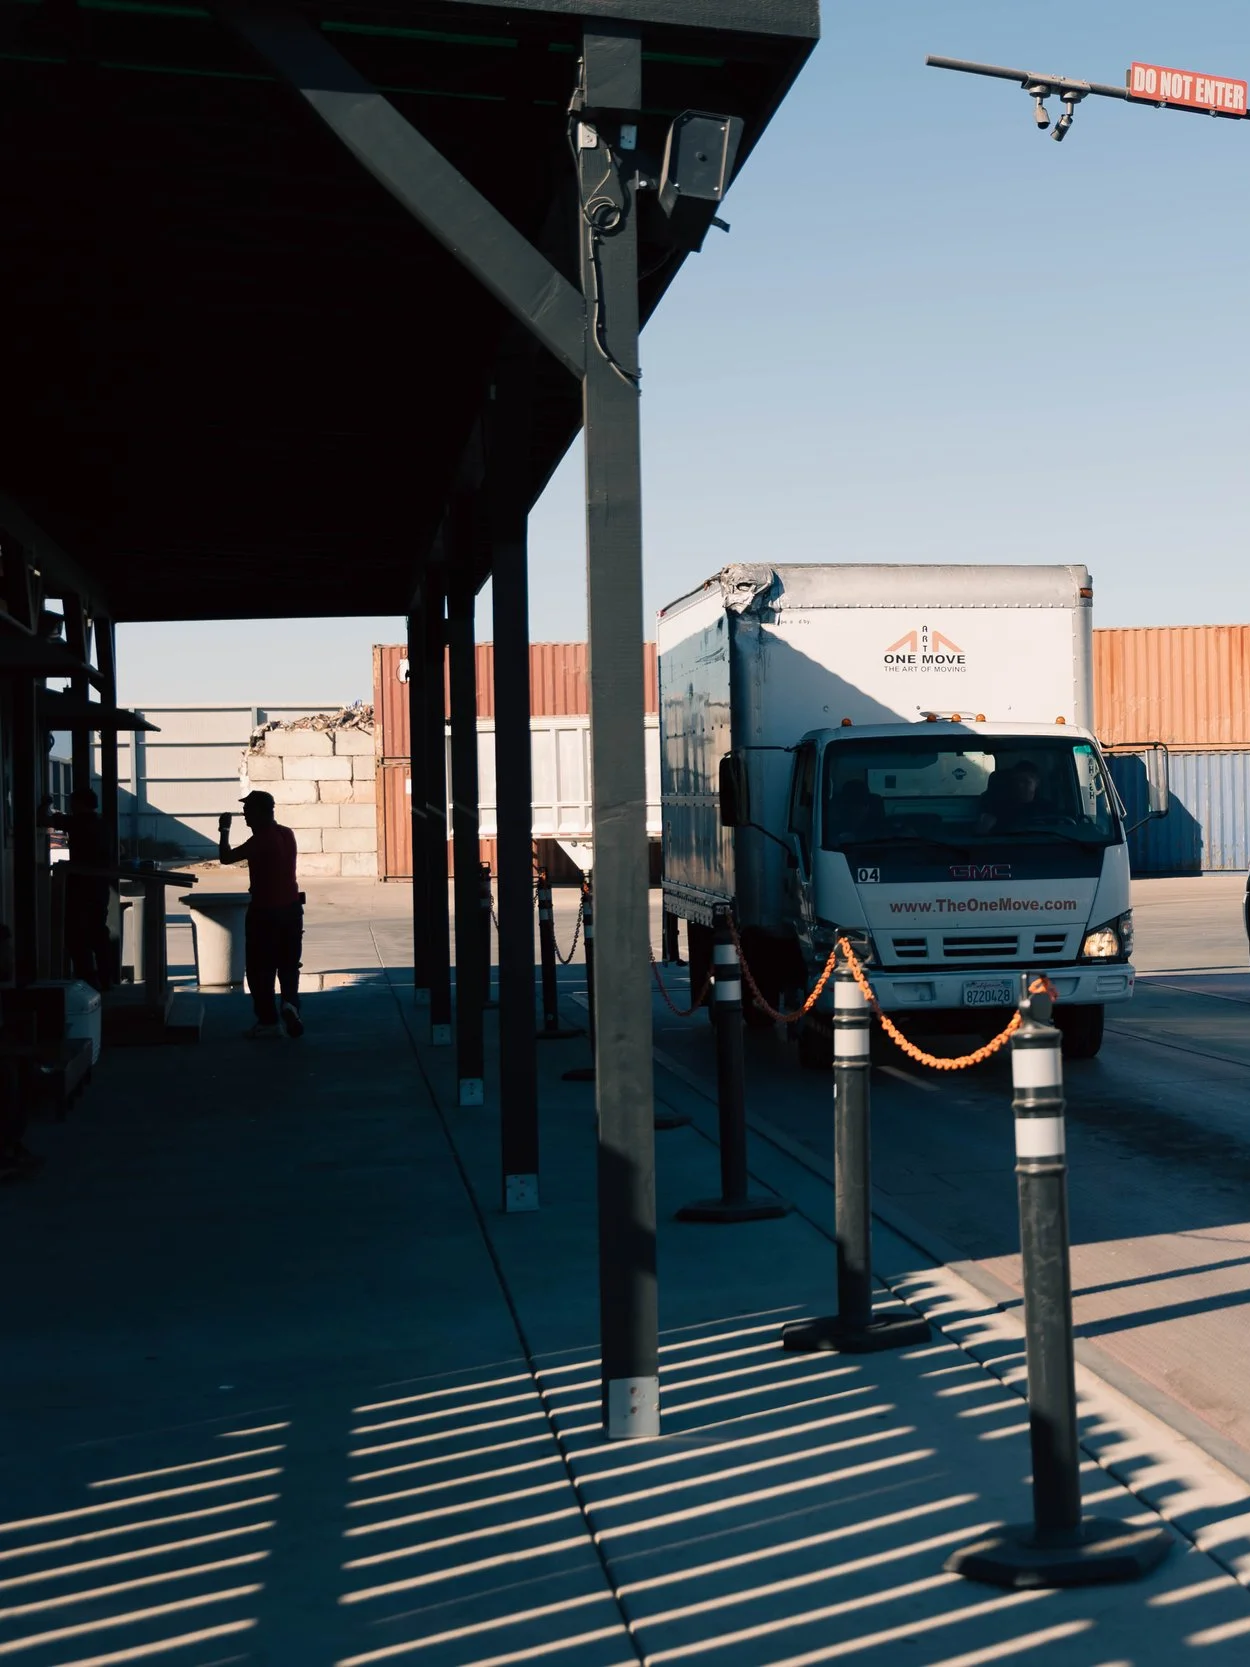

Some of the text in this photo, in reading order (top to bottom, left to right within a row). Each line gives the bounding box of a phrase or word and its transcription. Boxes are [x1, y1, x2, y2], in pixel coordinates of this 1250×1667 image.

[1133, 66, 1245, 110] DO NOT ENTER
[884, 654, 966, 664] ONE MOVE
[858, 868, 879, 882] 04
[949, 864, 1011, 879] GMC
[890, 898, 1077, 913] www.TheOneMove.com
[966, 989, 1010, 1003] 8Z20428
